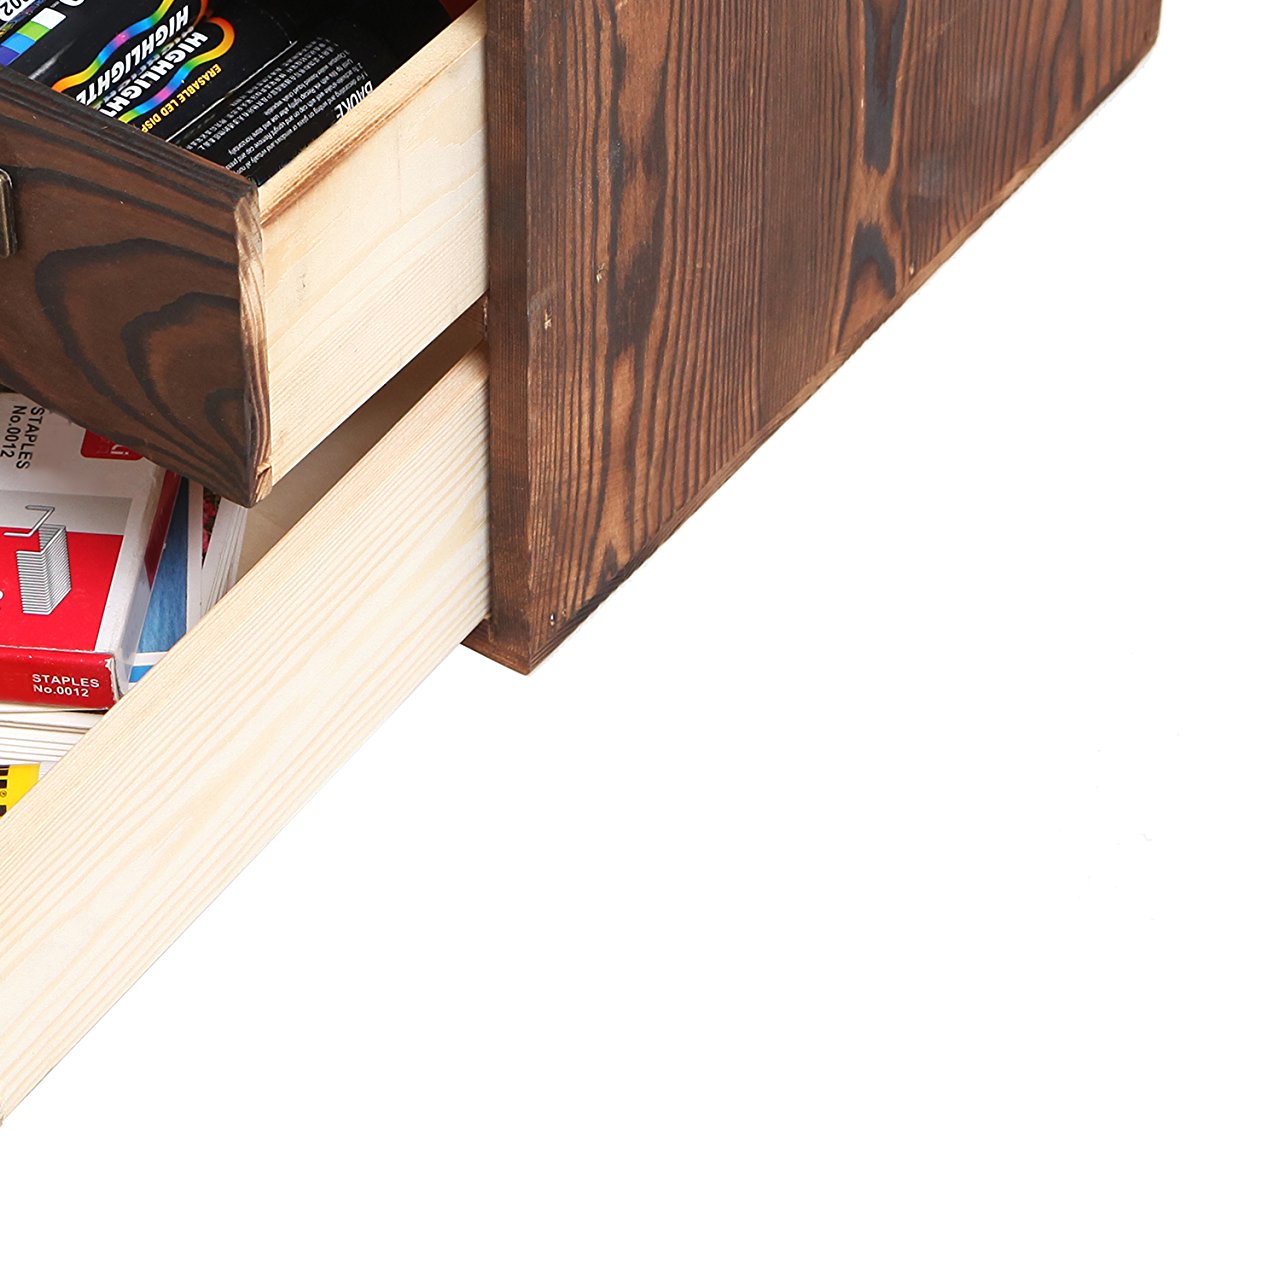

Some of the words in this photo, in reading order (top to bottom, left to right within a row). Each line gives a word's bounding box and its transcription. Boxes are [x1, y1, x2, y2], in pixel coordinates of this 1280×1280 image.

[177, 64, 221, 102] ERASABLE
[160, 100, 178, 116] LED
[0, 405, 27, 458] No.0012
[16, 406, 45, 470] STAPLES
[31, 673, 100, 689] STAPLES
[32, 683, 90, 698] No.0012
